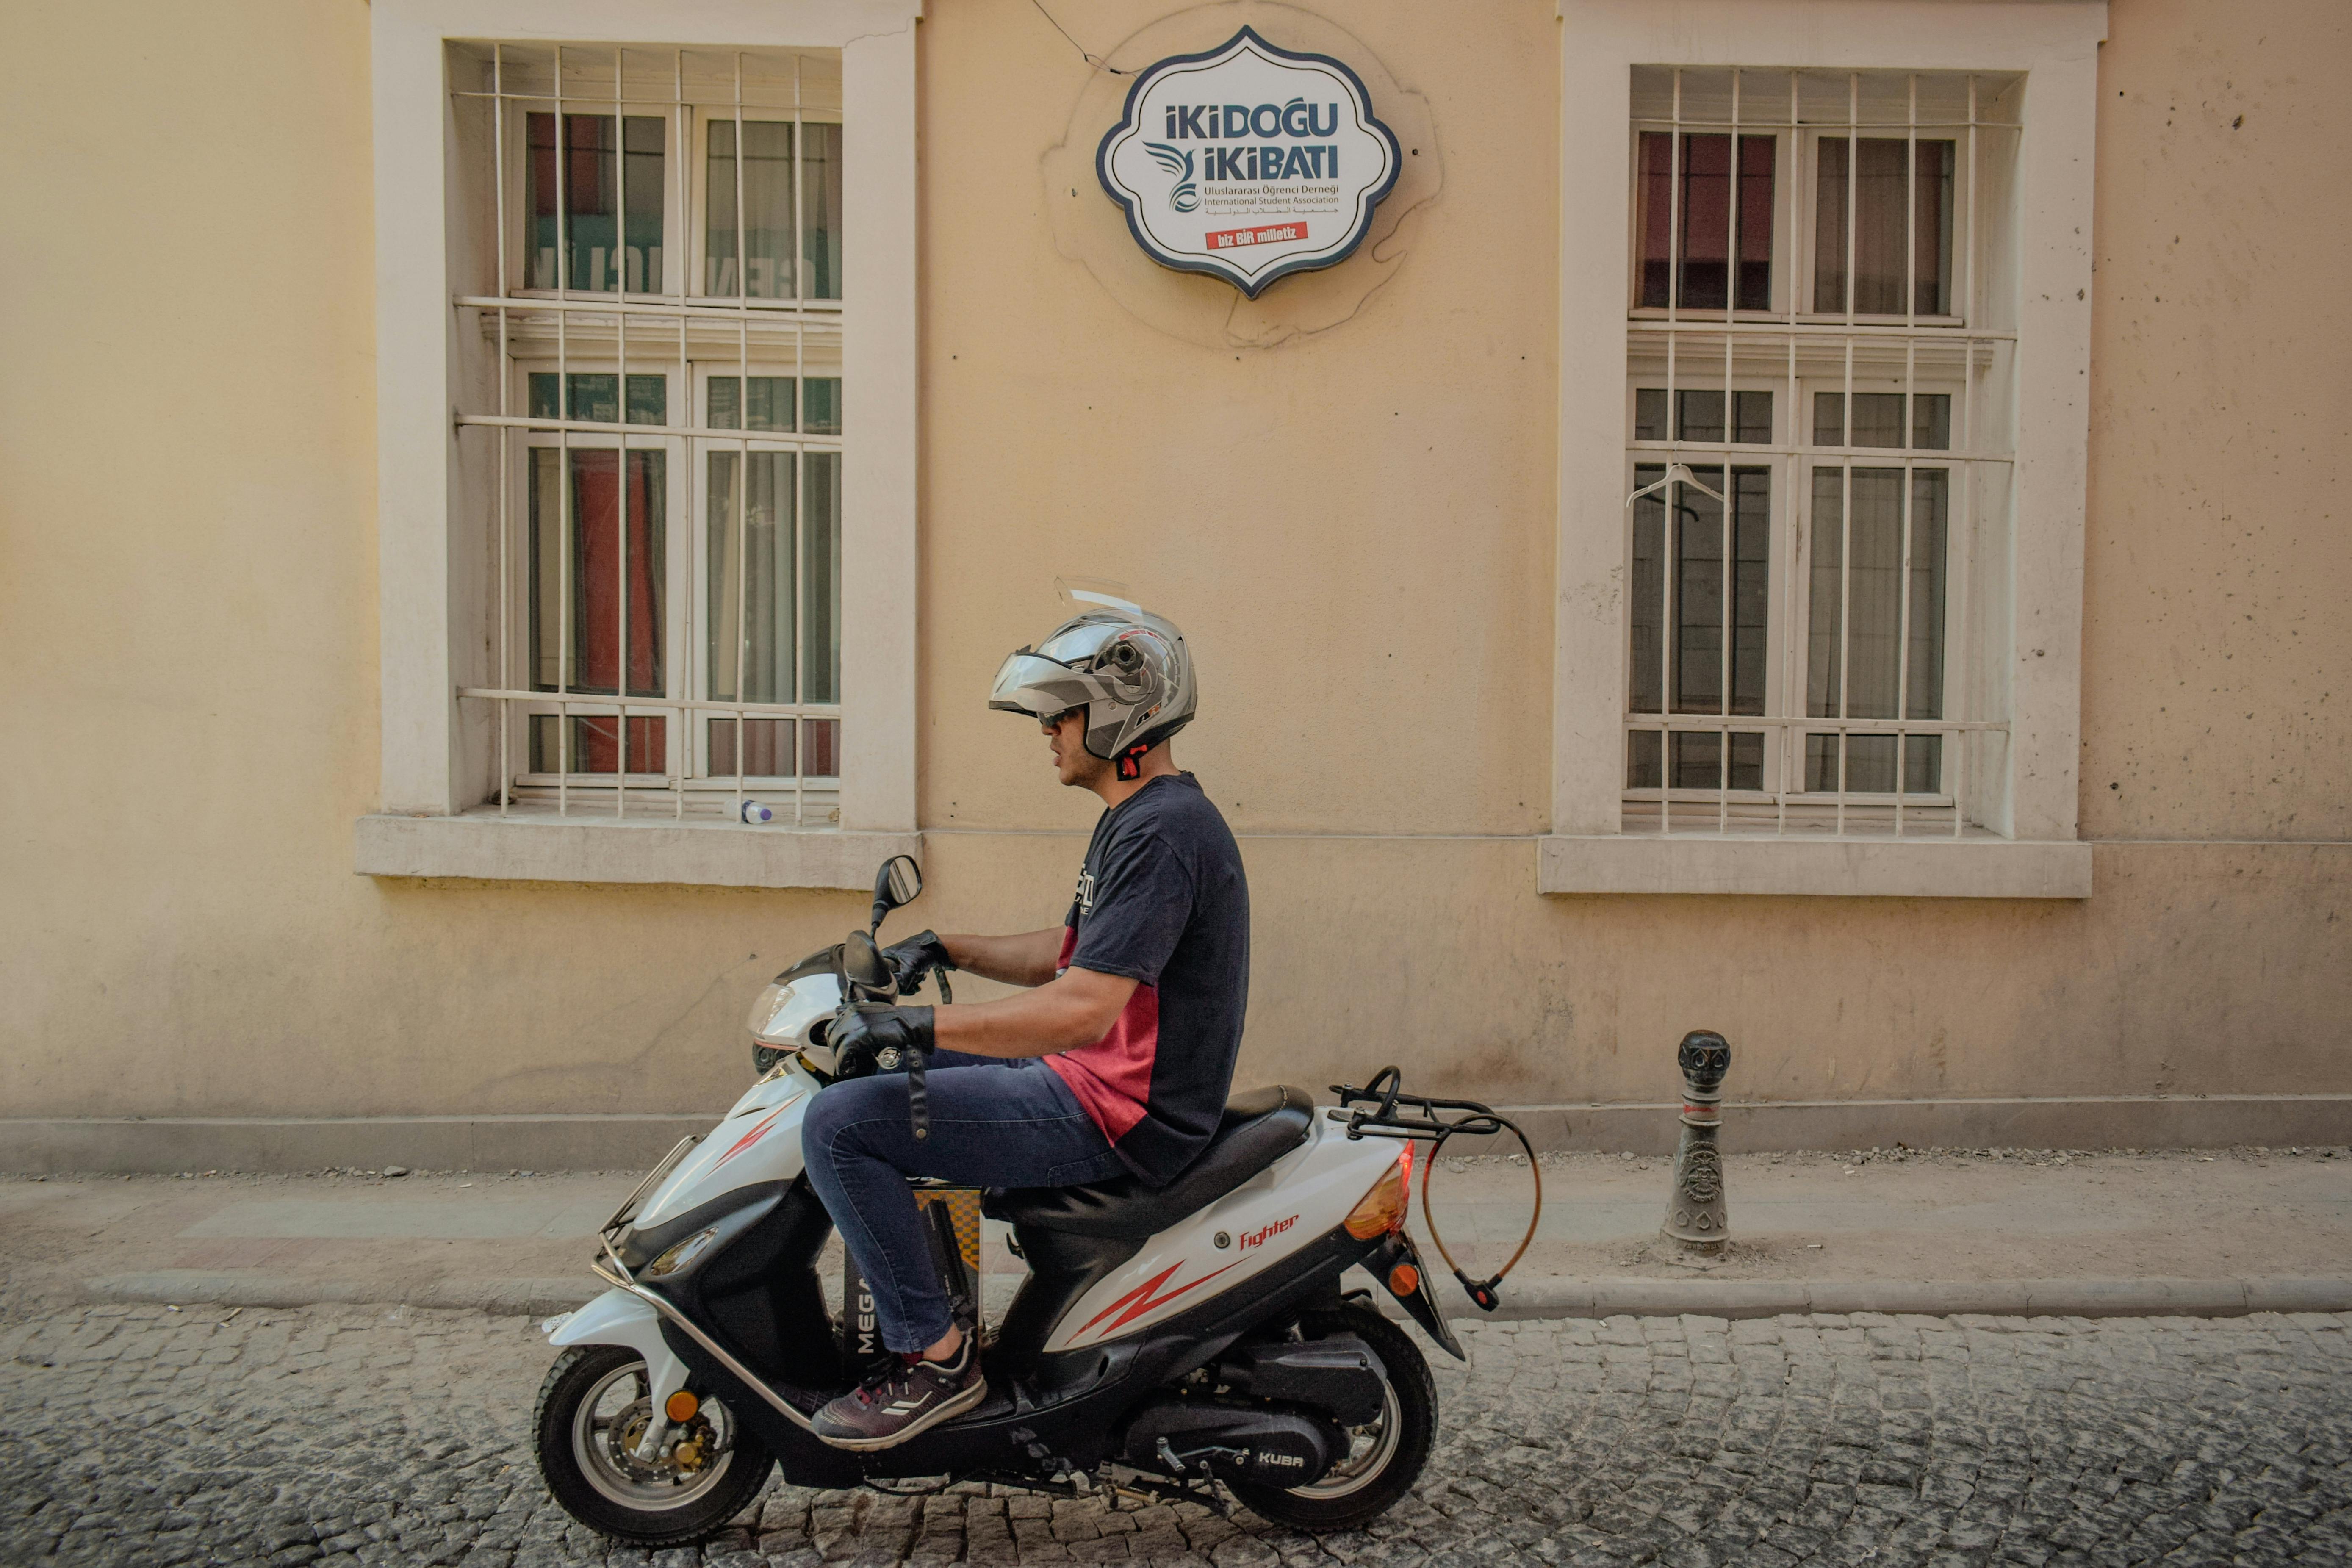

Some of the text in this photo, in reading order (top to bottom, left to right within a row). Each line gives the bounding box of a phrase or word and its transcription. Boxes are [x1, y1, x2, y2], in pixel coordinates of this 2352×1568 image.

[1205, 185, 1338, 196] Uluslararası Öğrenci Derneği
[1205, 197, 1256, 205] International
[1293, 196, 1339, 204] Association
[1217, 226, 1297, 248] biz BİR milletiz
[1239, 1214, 1299, 1251] Fighter
[1259, 1452, 1304, 1467] KUBA
